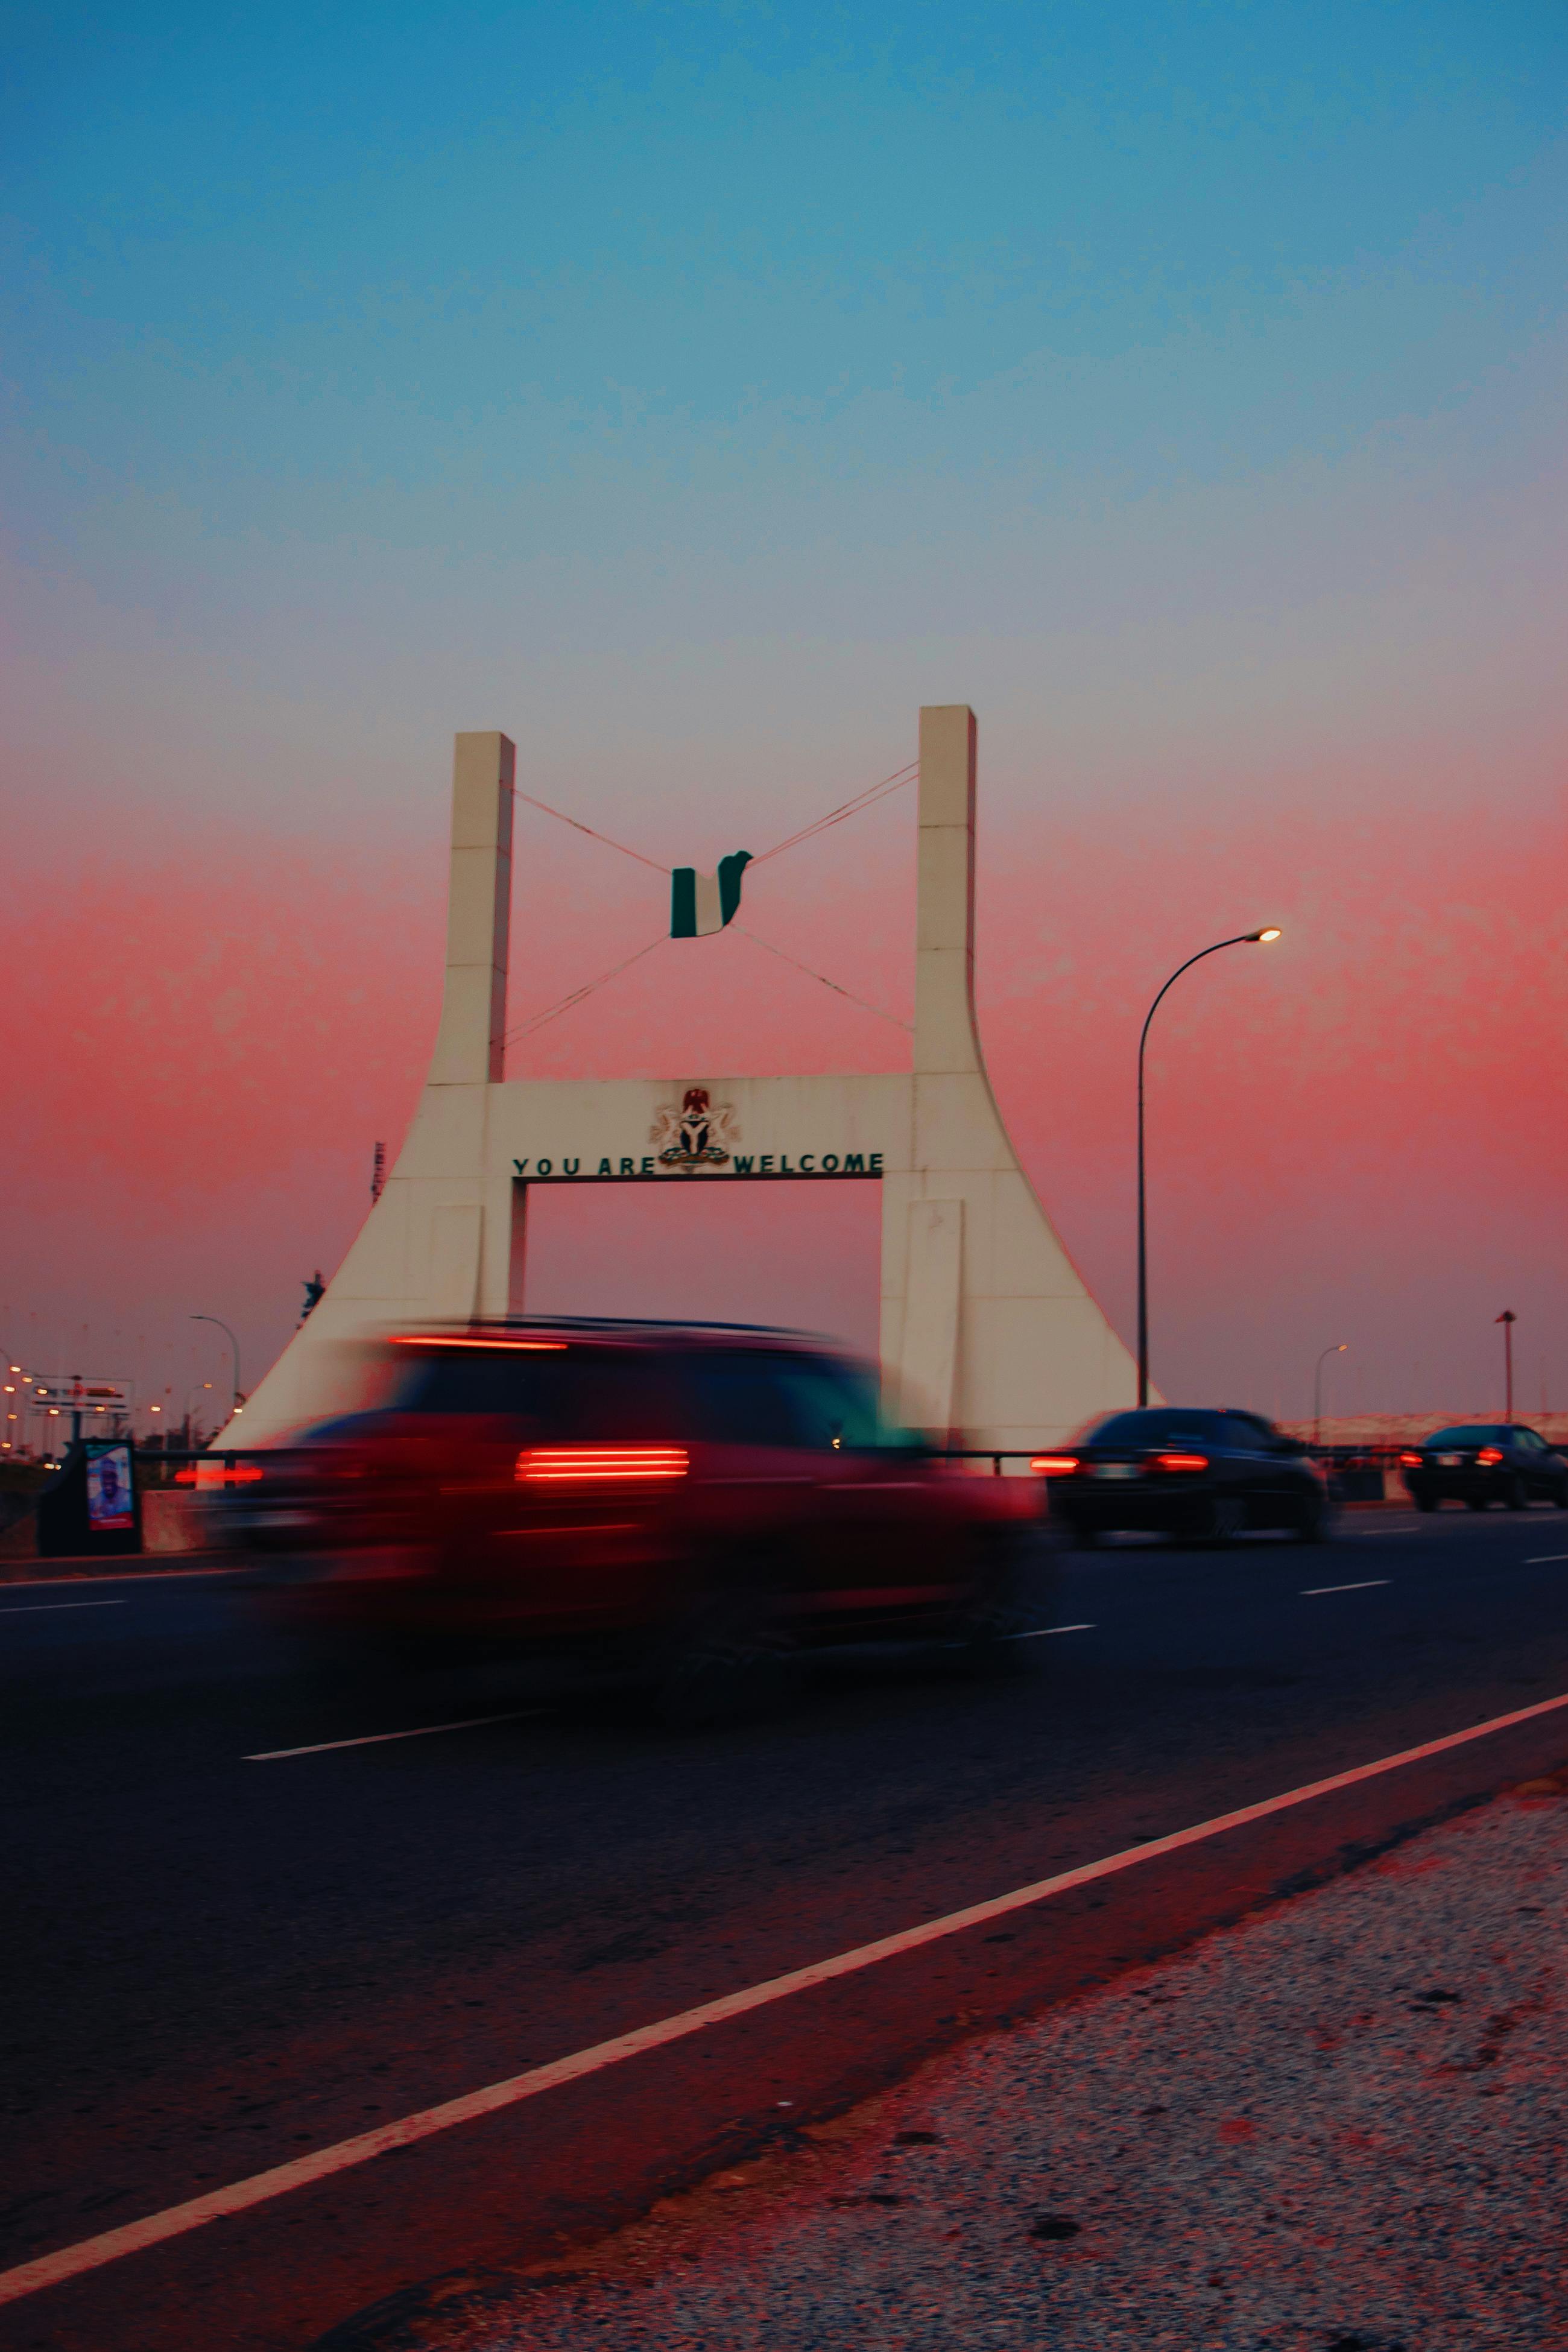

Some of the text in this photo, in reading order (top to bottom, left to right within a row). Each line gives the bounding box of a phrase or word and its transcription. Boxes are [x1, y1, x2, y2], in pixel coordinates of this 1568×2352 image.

[513, 1153, 884, 1175] YOU ARE WELCOME
